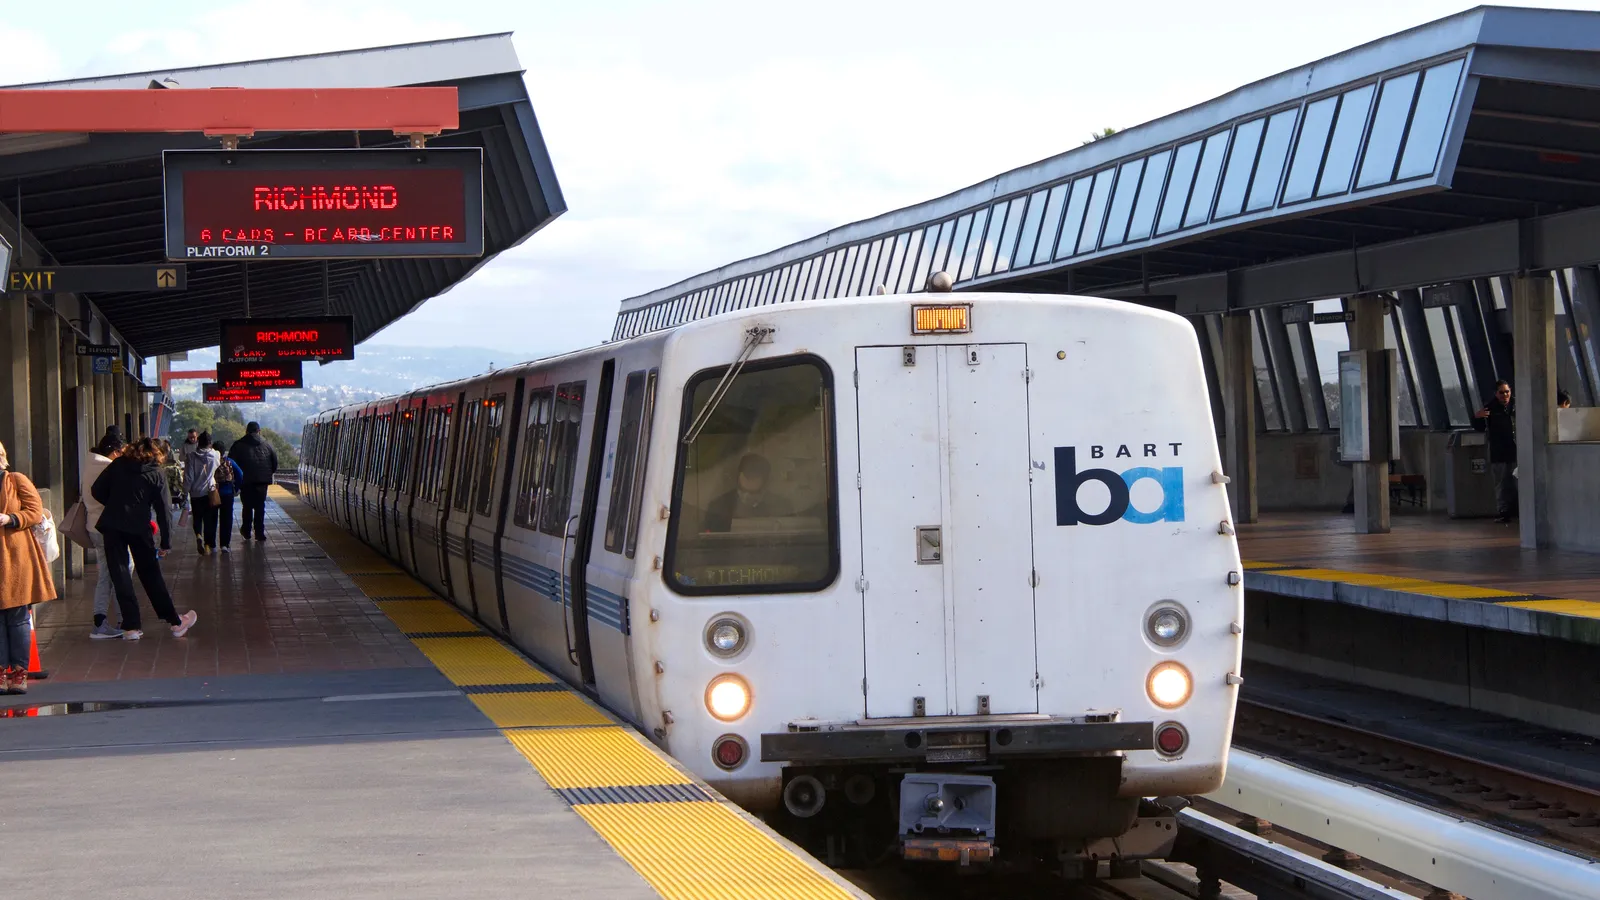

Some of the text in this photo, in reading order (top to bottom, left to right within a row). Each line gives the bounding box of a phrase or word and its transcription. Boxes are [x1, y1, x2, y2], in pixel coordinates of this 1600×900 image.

[254, 186, 397, 210] RICHMOND
[201, 229, 212, 242] 6
[380, 226, 454, 241] CENTER
[187, 245, 269, 257] PLATFORM 2
[10, 271, 56, 290] EXIT
[256, 330, 319, 342] RICHMOND
[1091, 442, 1183, 459] BART
